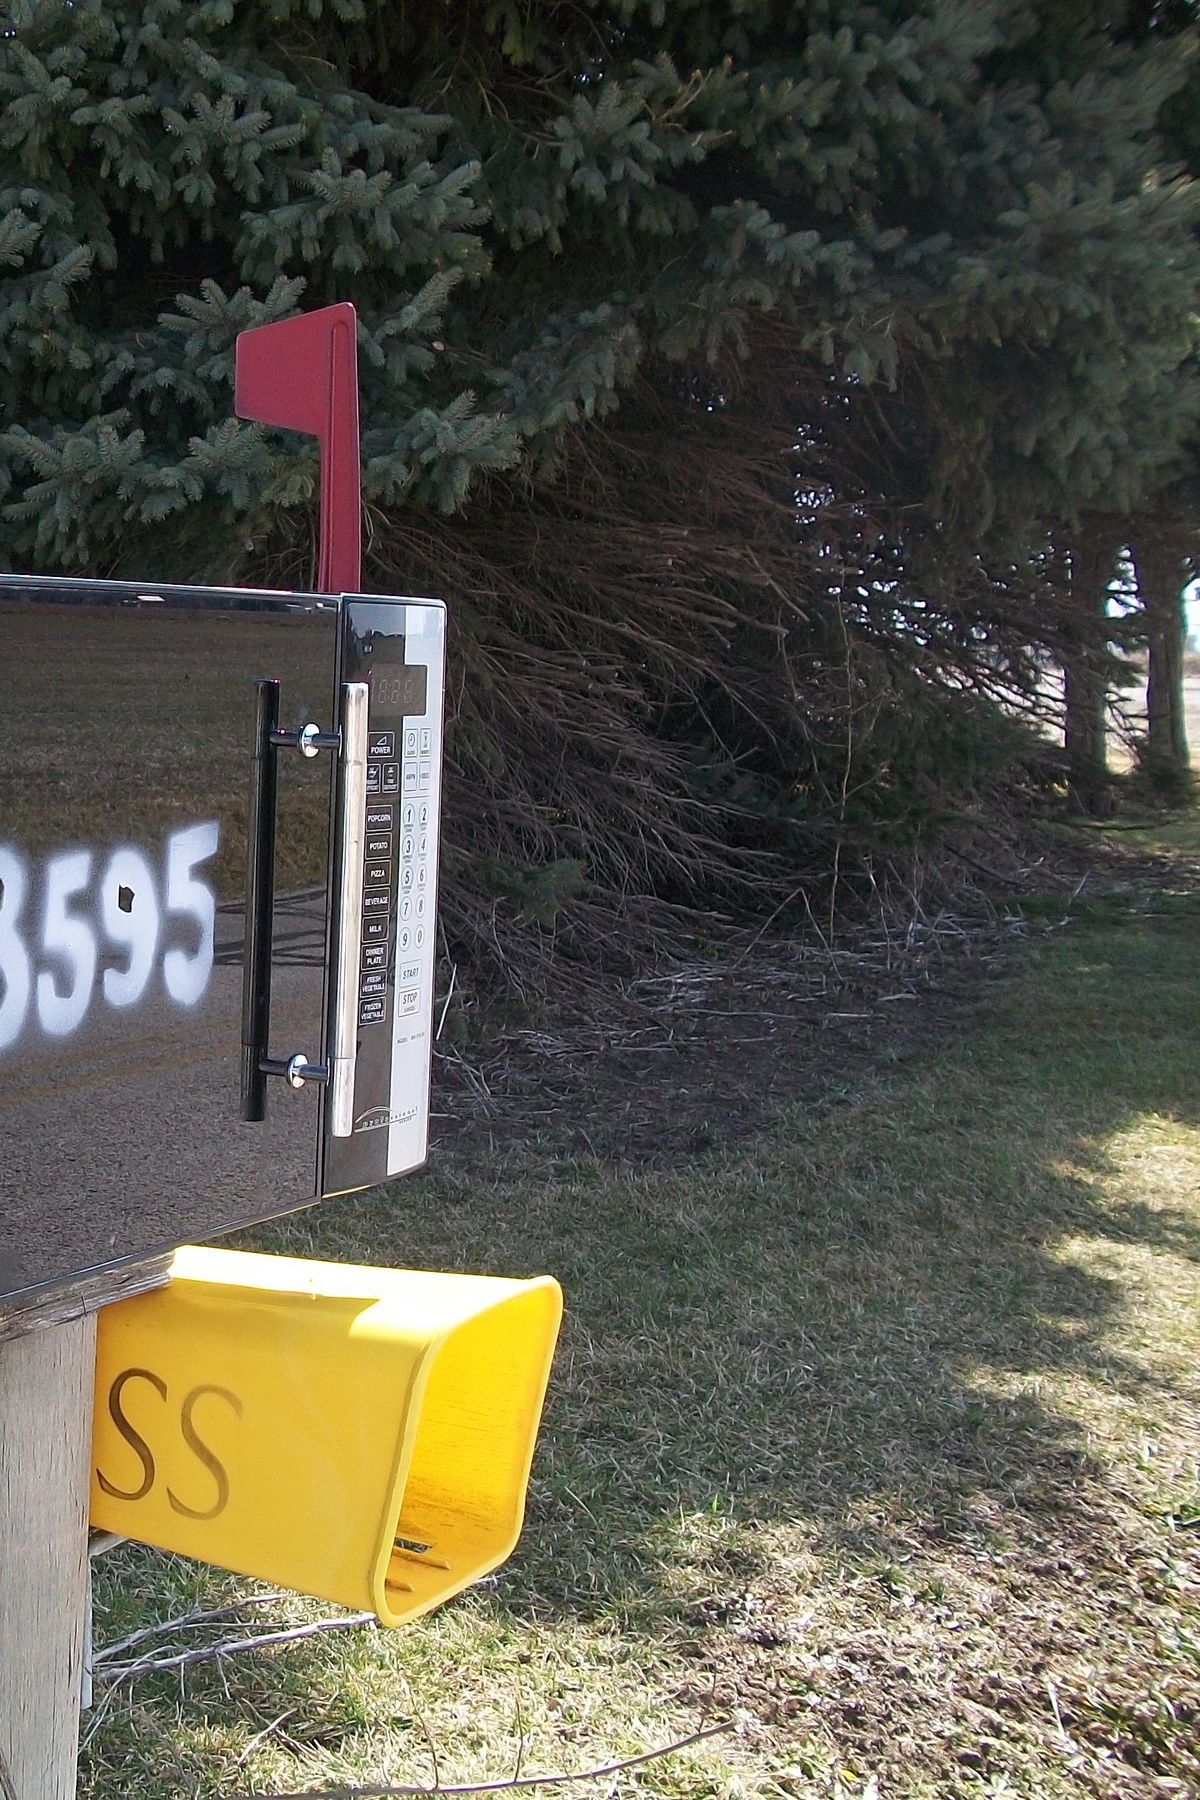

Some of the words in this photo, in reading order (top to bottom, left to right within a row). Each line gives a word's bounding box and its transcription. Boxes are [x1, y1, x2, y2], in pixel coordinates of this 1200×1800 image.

[371, 746, 390, 754] POWER
[367, 814, 391, 823] POPCORN
[369, 842, 388, 850] POTATO
[370, 870, 385, 878] PIZZA
[365, 897, 388, 906] BEVERAGE
[369, 925, 382, 933] MILK
[367, 957, 382, 965] PLATE
[402, 967, 419, 980] START
[402, 992, 418, 1005] STOP
[96, 1367, 243, 1521] SS
